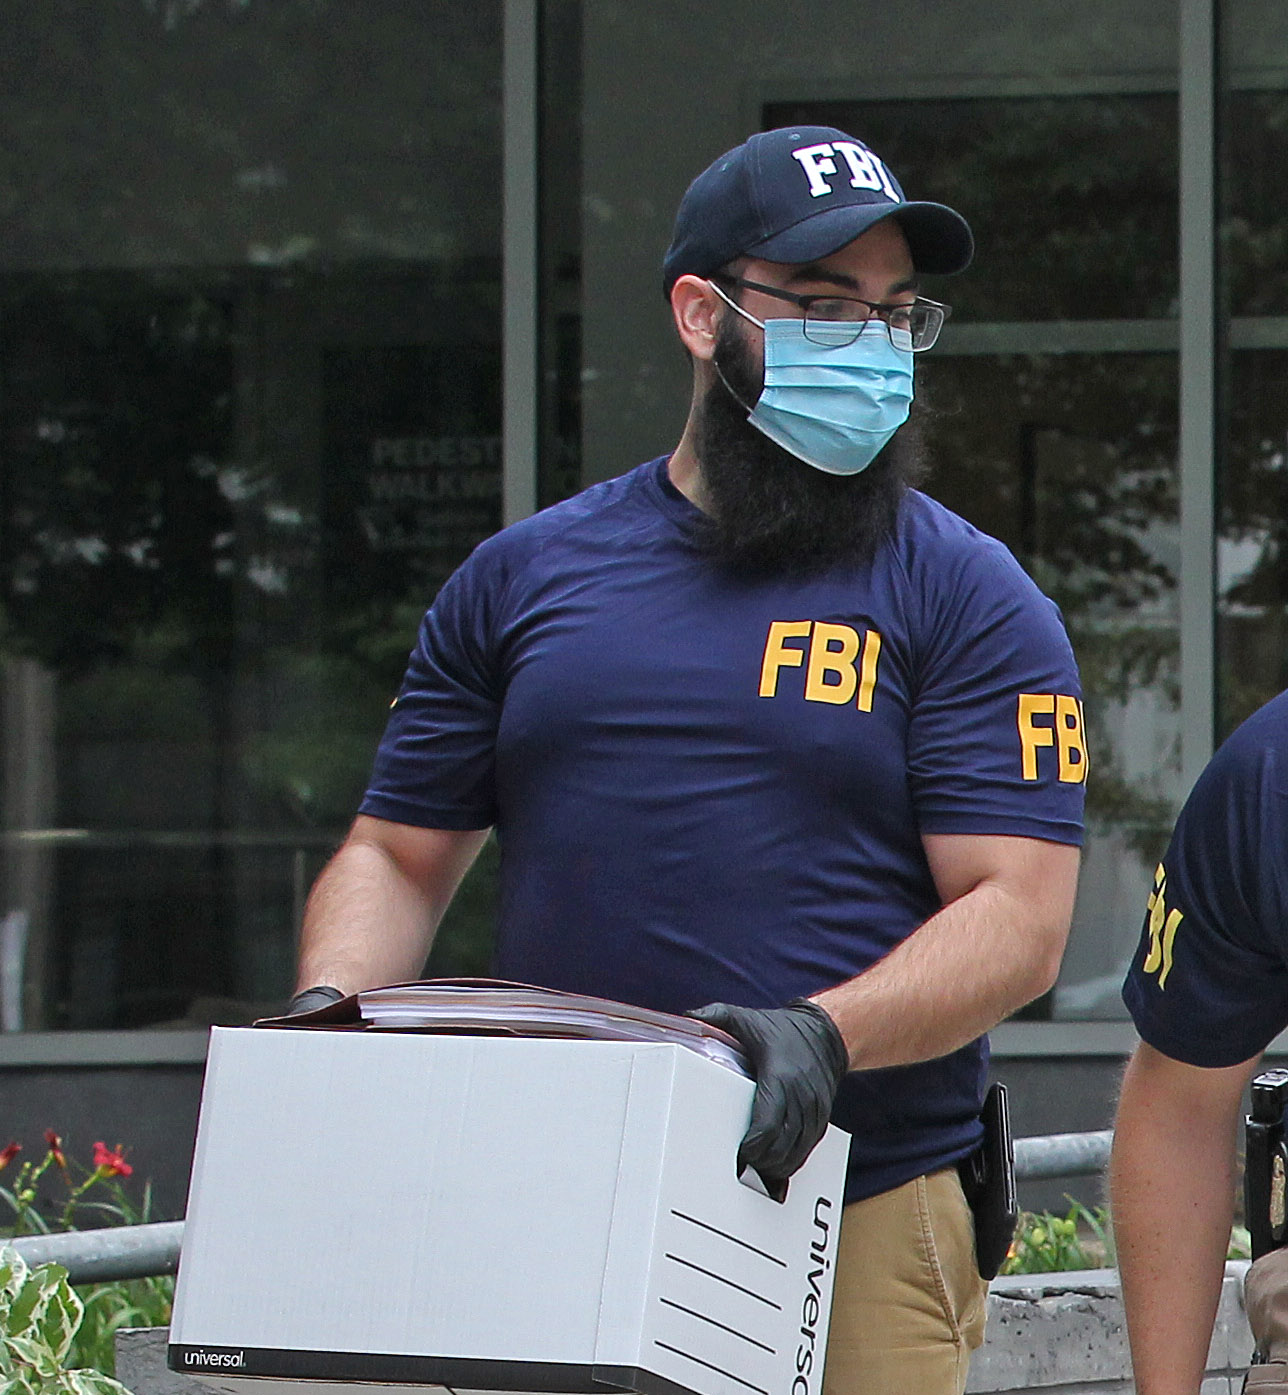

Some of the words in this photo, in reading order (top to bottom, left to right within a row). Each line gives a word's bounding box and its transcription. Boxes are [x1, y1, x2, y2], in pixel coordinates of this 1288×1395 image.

[791, 140, 901, 204] FBI
[758, 619, 882, 713] FBI
[1017, 693, 1090, 787] FB
